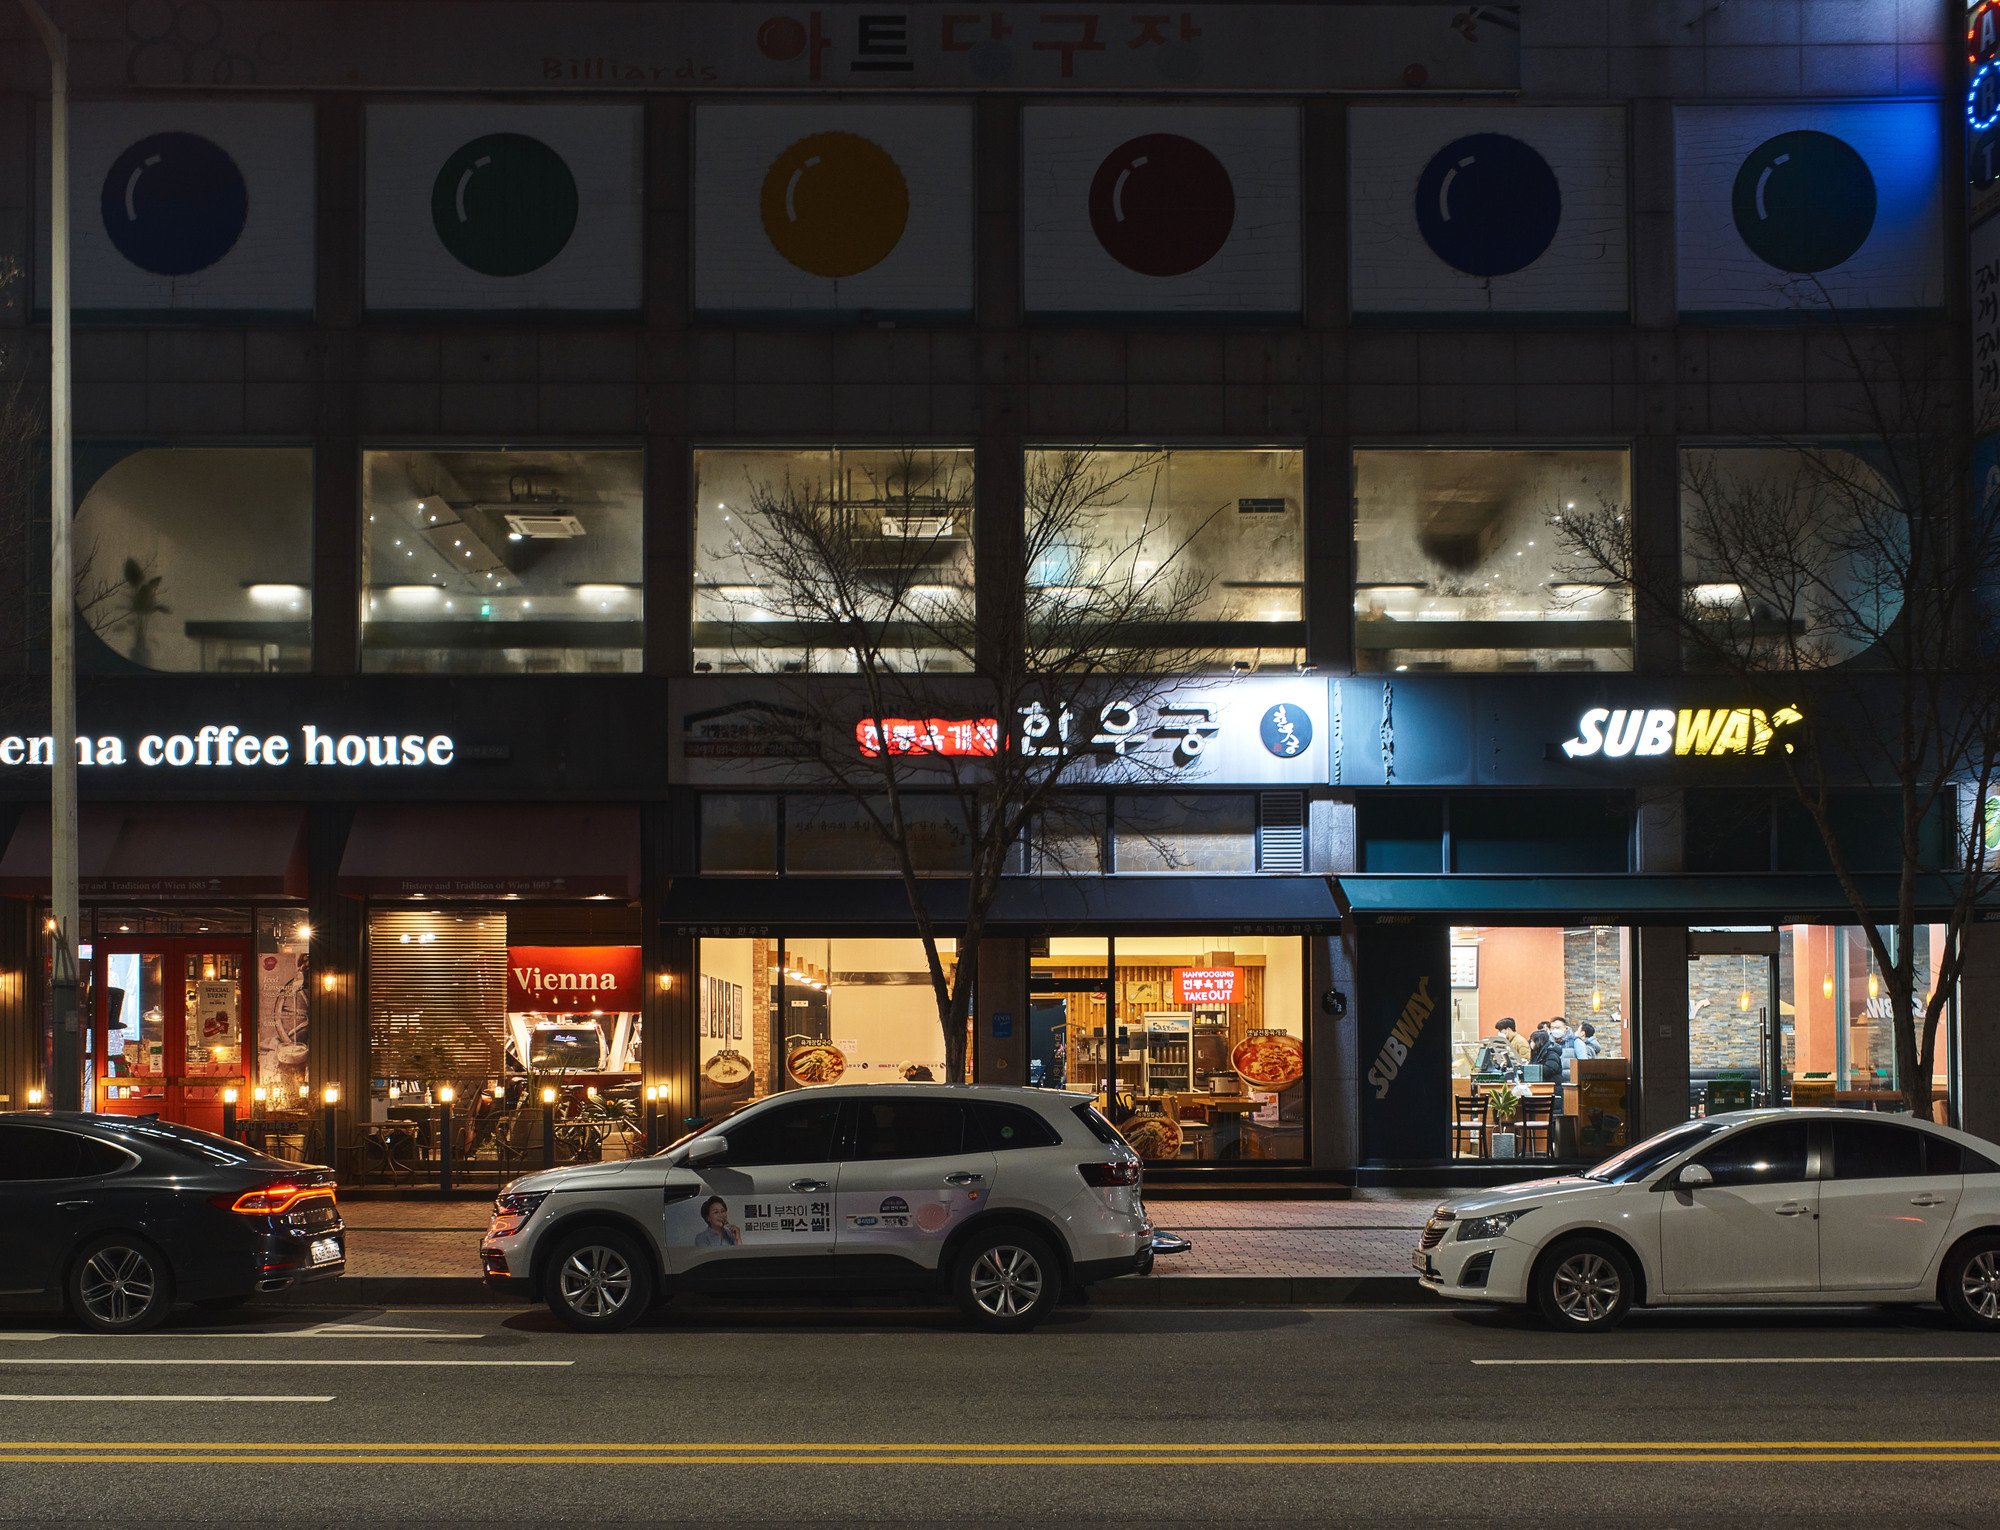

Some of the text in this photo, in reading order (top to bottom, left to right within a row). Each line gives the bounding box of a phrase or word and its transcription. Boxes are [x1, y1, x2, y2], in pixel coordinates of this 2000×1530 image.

[541, 57, 717, 80] Billiards
[1018, 701, 1220, 757] 한우궁
[1561, 703, 1803, 757] SUBWAY
[863, 723, 998, 752] 전통육개장
[139, 726, 289, 766] coffee
[302, 726, 453, 766] house
[92, 881, 107, 890] and
[112, 881, 150, 890] Tradition
[152, 881, 161, 890] of
[188, 881, 206, 890] 1683
[402, 881, 551, 892] History and Tradition of Wien 1683
[1376, 915, 1416, 924] SUBWAY
[1580, 915, 1619, 925] SUBWAY
[1782, 914, 1821, 924] SUBWAY
[512, 967, 618, 991] Vienna
[1182, 979, 1235, 990] 전통육개장
[1183, 990, 1233, 1001] TAKE OUT
[1368, 976, 1435, 1100] SUBWAY
[744, 1202, 830, 1218] 틀니 부착이 착!
[744, 1218, 830, 1232] 폴리덴트 맥스 씰!
